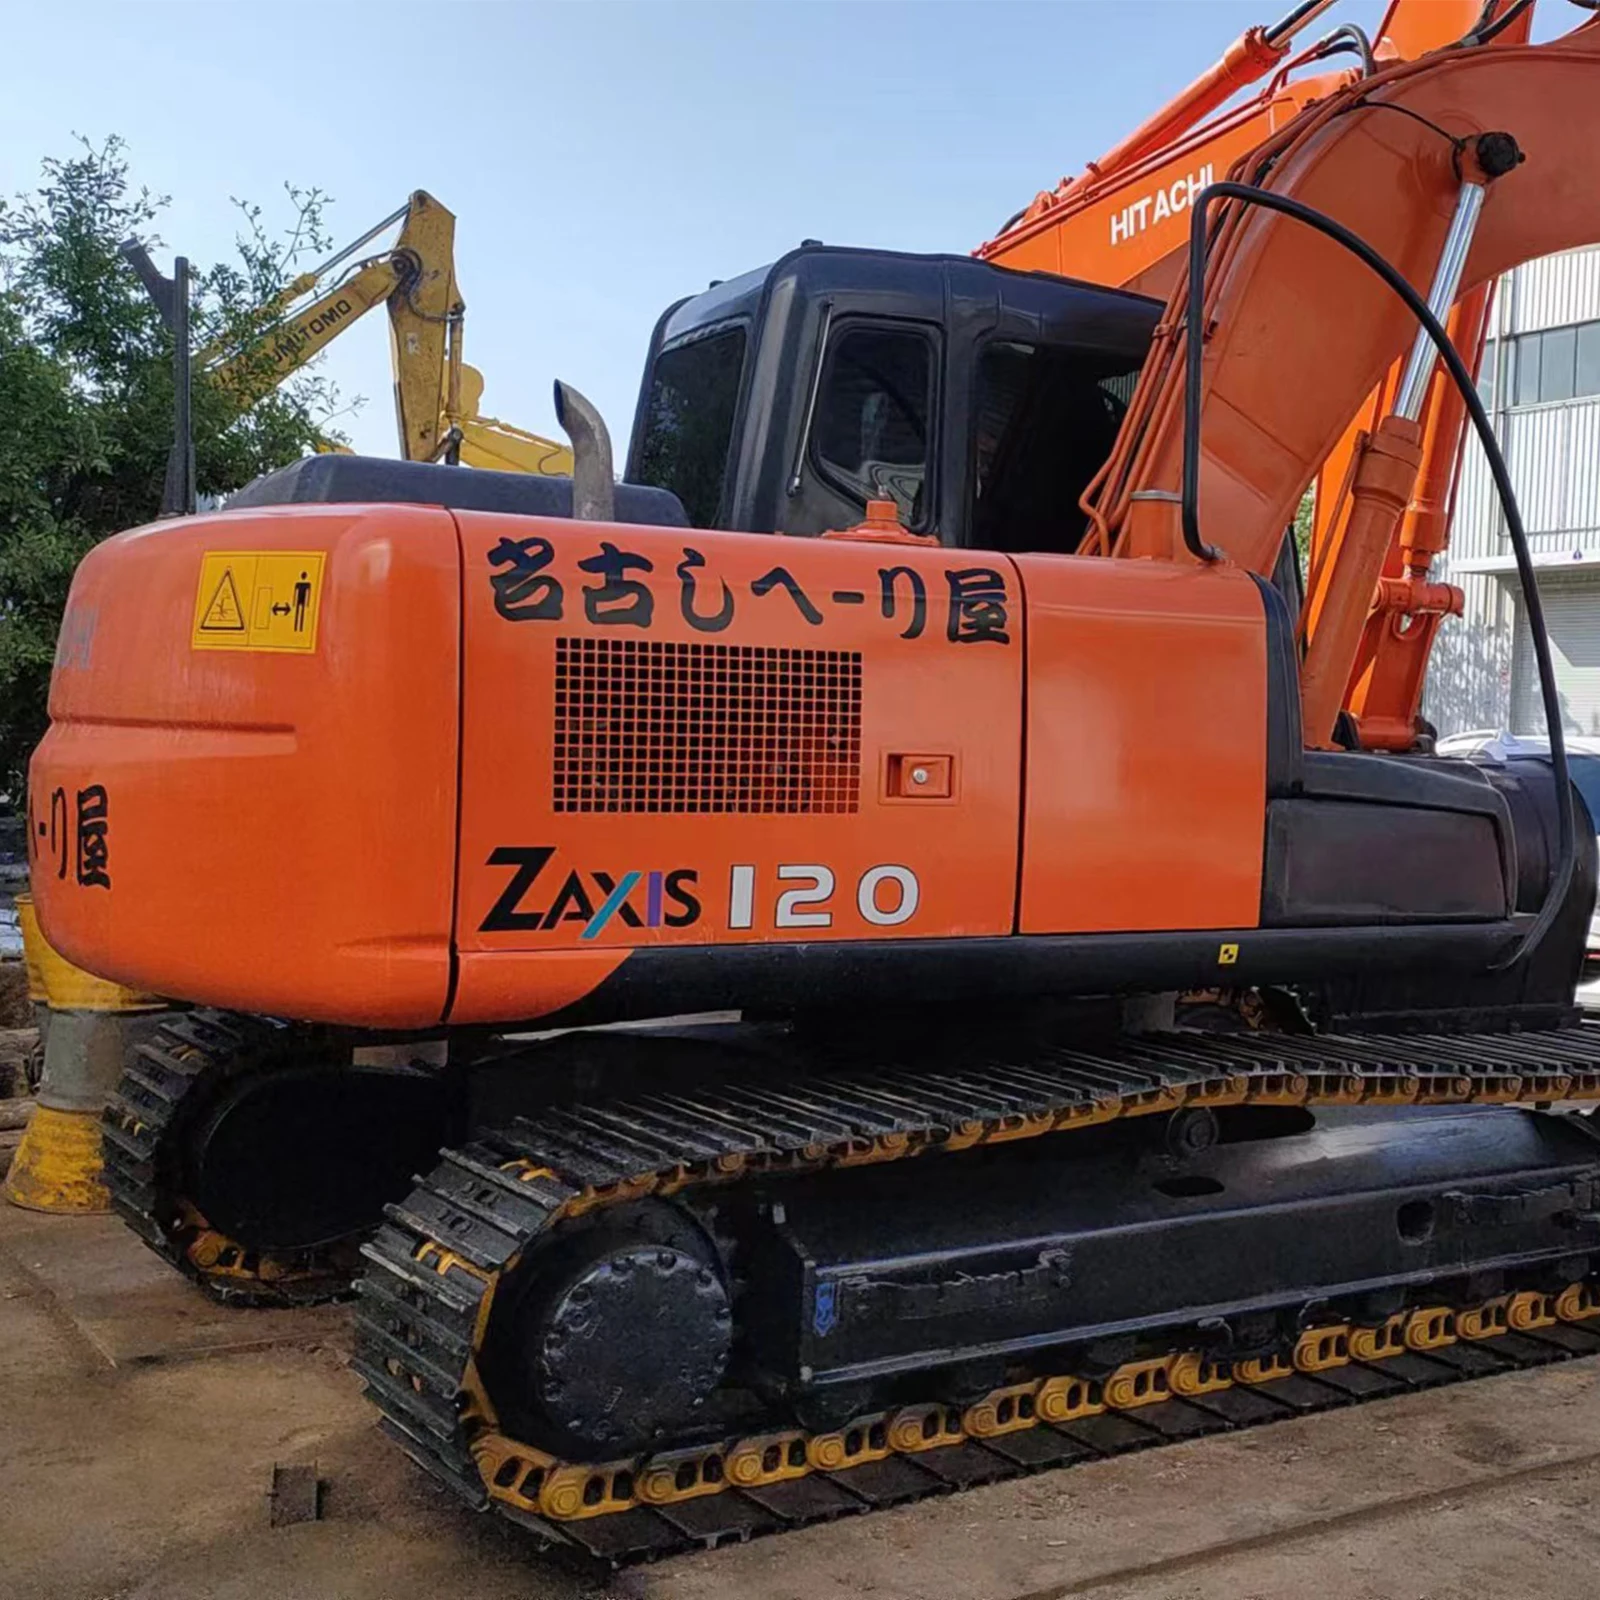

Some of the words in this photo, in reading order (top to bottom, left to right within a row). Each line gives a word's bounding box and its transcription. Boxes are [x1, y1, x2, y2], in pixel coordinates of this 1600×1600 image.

[1110, 163, 1214, 246] HITACHI
[268, 299, 352, 364] UMITOMO
[477, 846, 701, 939] ZAXIS
[727, 863, 920, 929] 120
